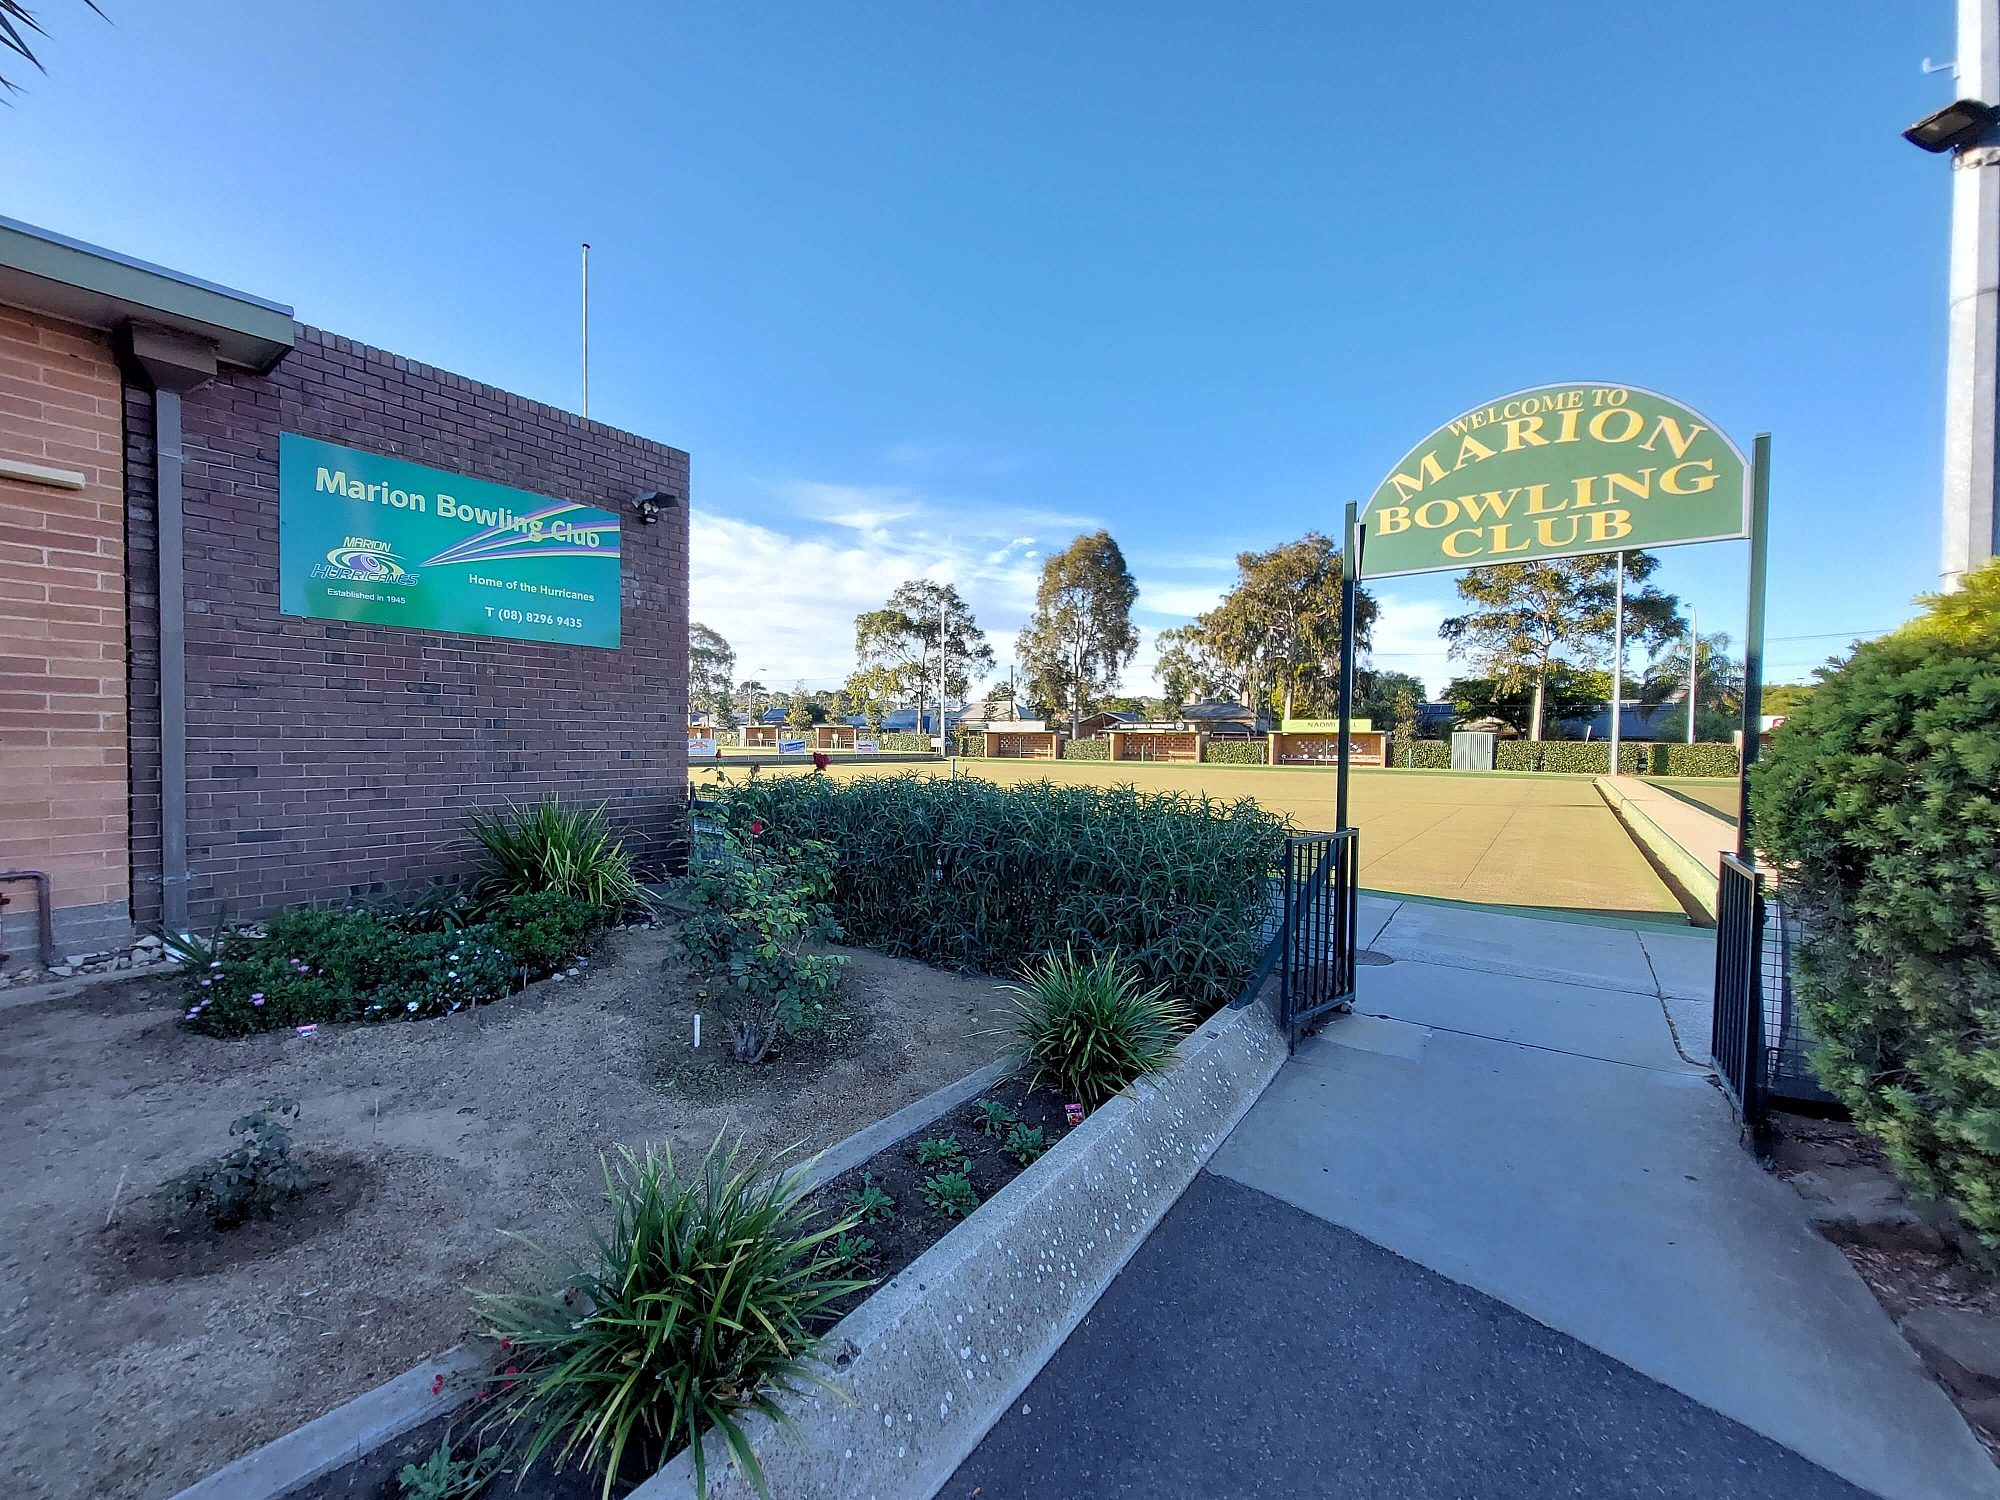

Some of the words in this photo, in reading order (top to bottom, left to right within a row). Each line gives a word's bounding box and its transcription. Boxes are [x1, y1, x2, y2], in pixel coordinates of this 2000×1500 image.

[1447, 391, 1584, 438] WELCOME
[1591, 388, 1629, 407] TO
[1386, 408, 1708, 505] MARION
[315, 467, 426, 513] Marion
[436, 493, 544, 543] Bowling
[550, 519, 601, 549] Club
[1374, 457, 1721, 536] BOWLING
[342, 536, 392, 553] MARION
[1441, 508, 1633, 558] CLUB
[310, 563, 420, 587] HURRICANES
[469, 573, 503, 588] Home
[505, 580, 518, 590] of
[520, 582, 537, 593] the
[540, 585, 595, 602] Hurricanes
[327, 587, 375, 602] Established
[376, 593, 384, 602] in
[387, 595, 406, 605] 1945
[484, 606, 495, 618] T
[498, 608, 523, 624] (08)
[526, 612, 554, 625] 8296
[556, 616, 583, 629] 9435
